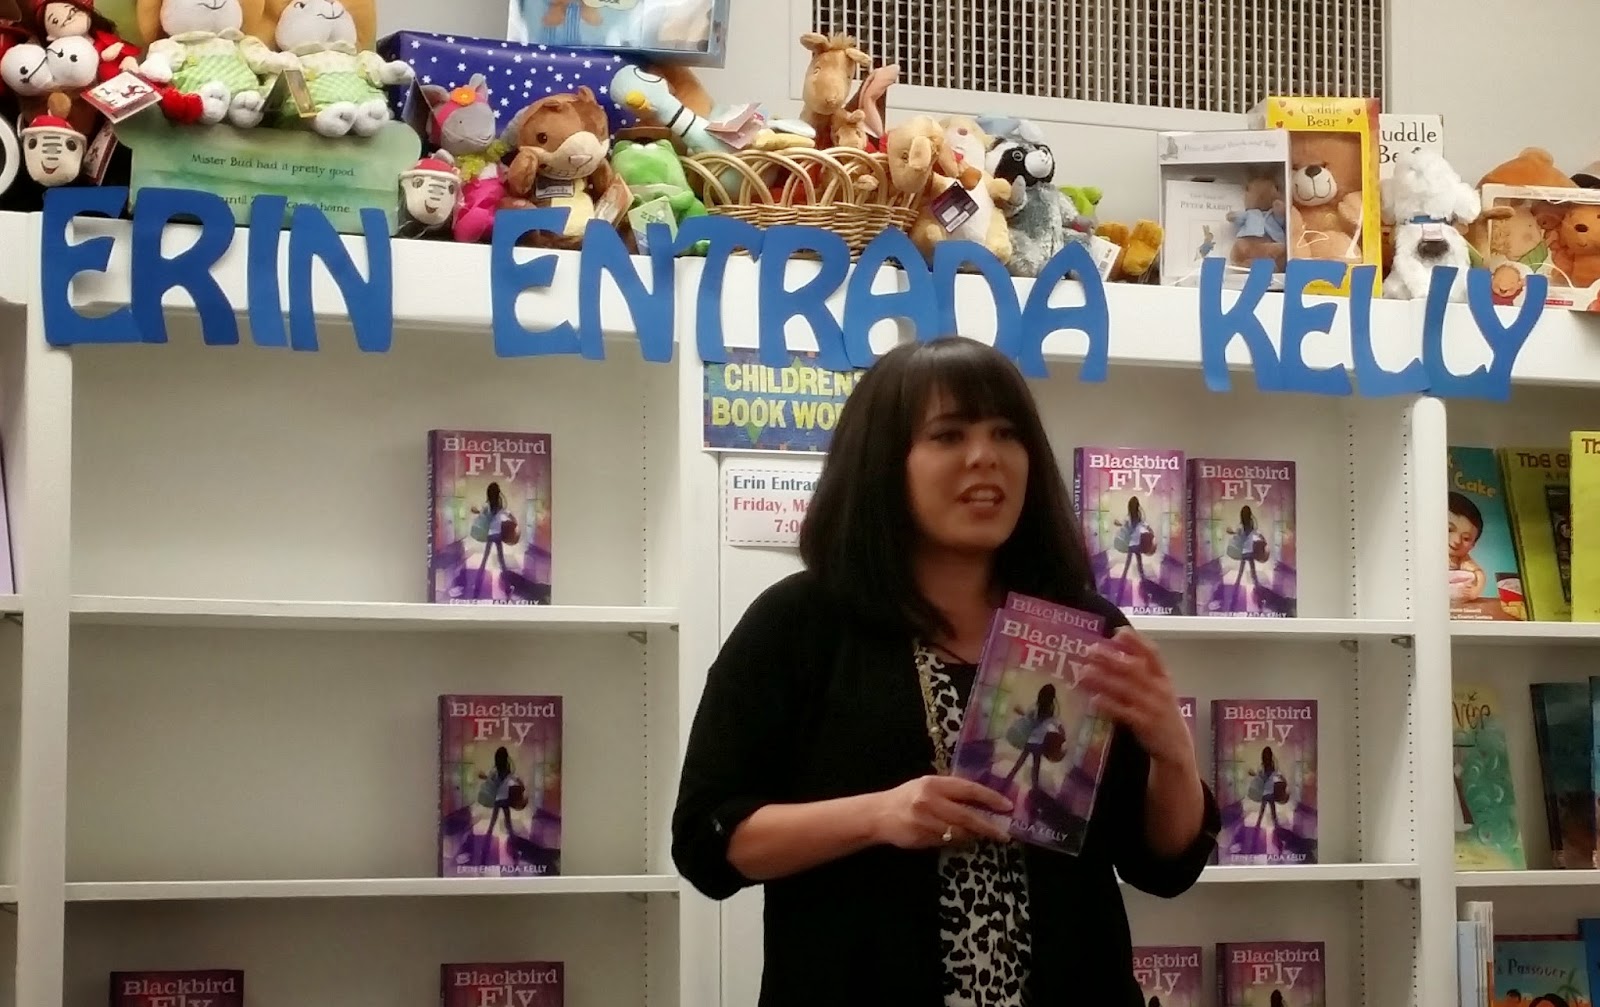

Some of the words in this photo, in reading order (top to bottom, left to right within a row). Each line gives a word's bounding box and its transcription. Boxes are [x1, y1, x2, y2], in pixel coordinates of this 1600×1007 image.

[1307, 115, 1339, 127] Bear
[1382, 122, 1437, 143] uddle
[191, 153, 226, 166] Mister
[230, 156, 253, 168] Bud
[256, 159, 277, 170] had
[291, 163, 326, 178] pretty
[41, 185, 394, 352] ERIN
[490, 206, 1110, 382] ENTRADA
[1199, 257, 1549, 401] KELLY
[711, 397, 787, 428] BOOK
[443, 437, 546, 455] Blackbird
[466, 453, 526, 482] Fly
[1089, 454, 1180, 471] Blackbird
[733, 475, 766, 490] Erin
[1109, 469, 1162, 496] Fly
[1201, 465, 1291, 482] Blackbird
[1221, 479, 1272, 507] Fly
[1454, 472, 1496, 498] Cake
[733, 496, 787, 514] Friday,
[774, 518, 800, 534] 7:0
[1010, 598, 1100, 633] Blackbird
[1000, 620, 1092, 658] Blackb
[1019, 643, 1091, 690] Fly
[450, 702, 556, 718] Blackbird
[1223, 705, 1312, 720] Blackbird
[474, 717, 534, 745] Fly
[1243, 719, 1294, 747] Fly
[523, 864, 548, 874] KELLY
[1133, 953, 1200, 969] ackbird
[1231, 948, 1321, 964] Blackbird
[453, 969, 558, 986] Blackbird
[1252, 962, 1303, 990] Fly
[1505, 957, 1567, 978] Passover
[123, 977, 236, 996] Blackbird
[1133, 969, 1182, 996] Fly
[478, 984, 537, 1007] Fly
